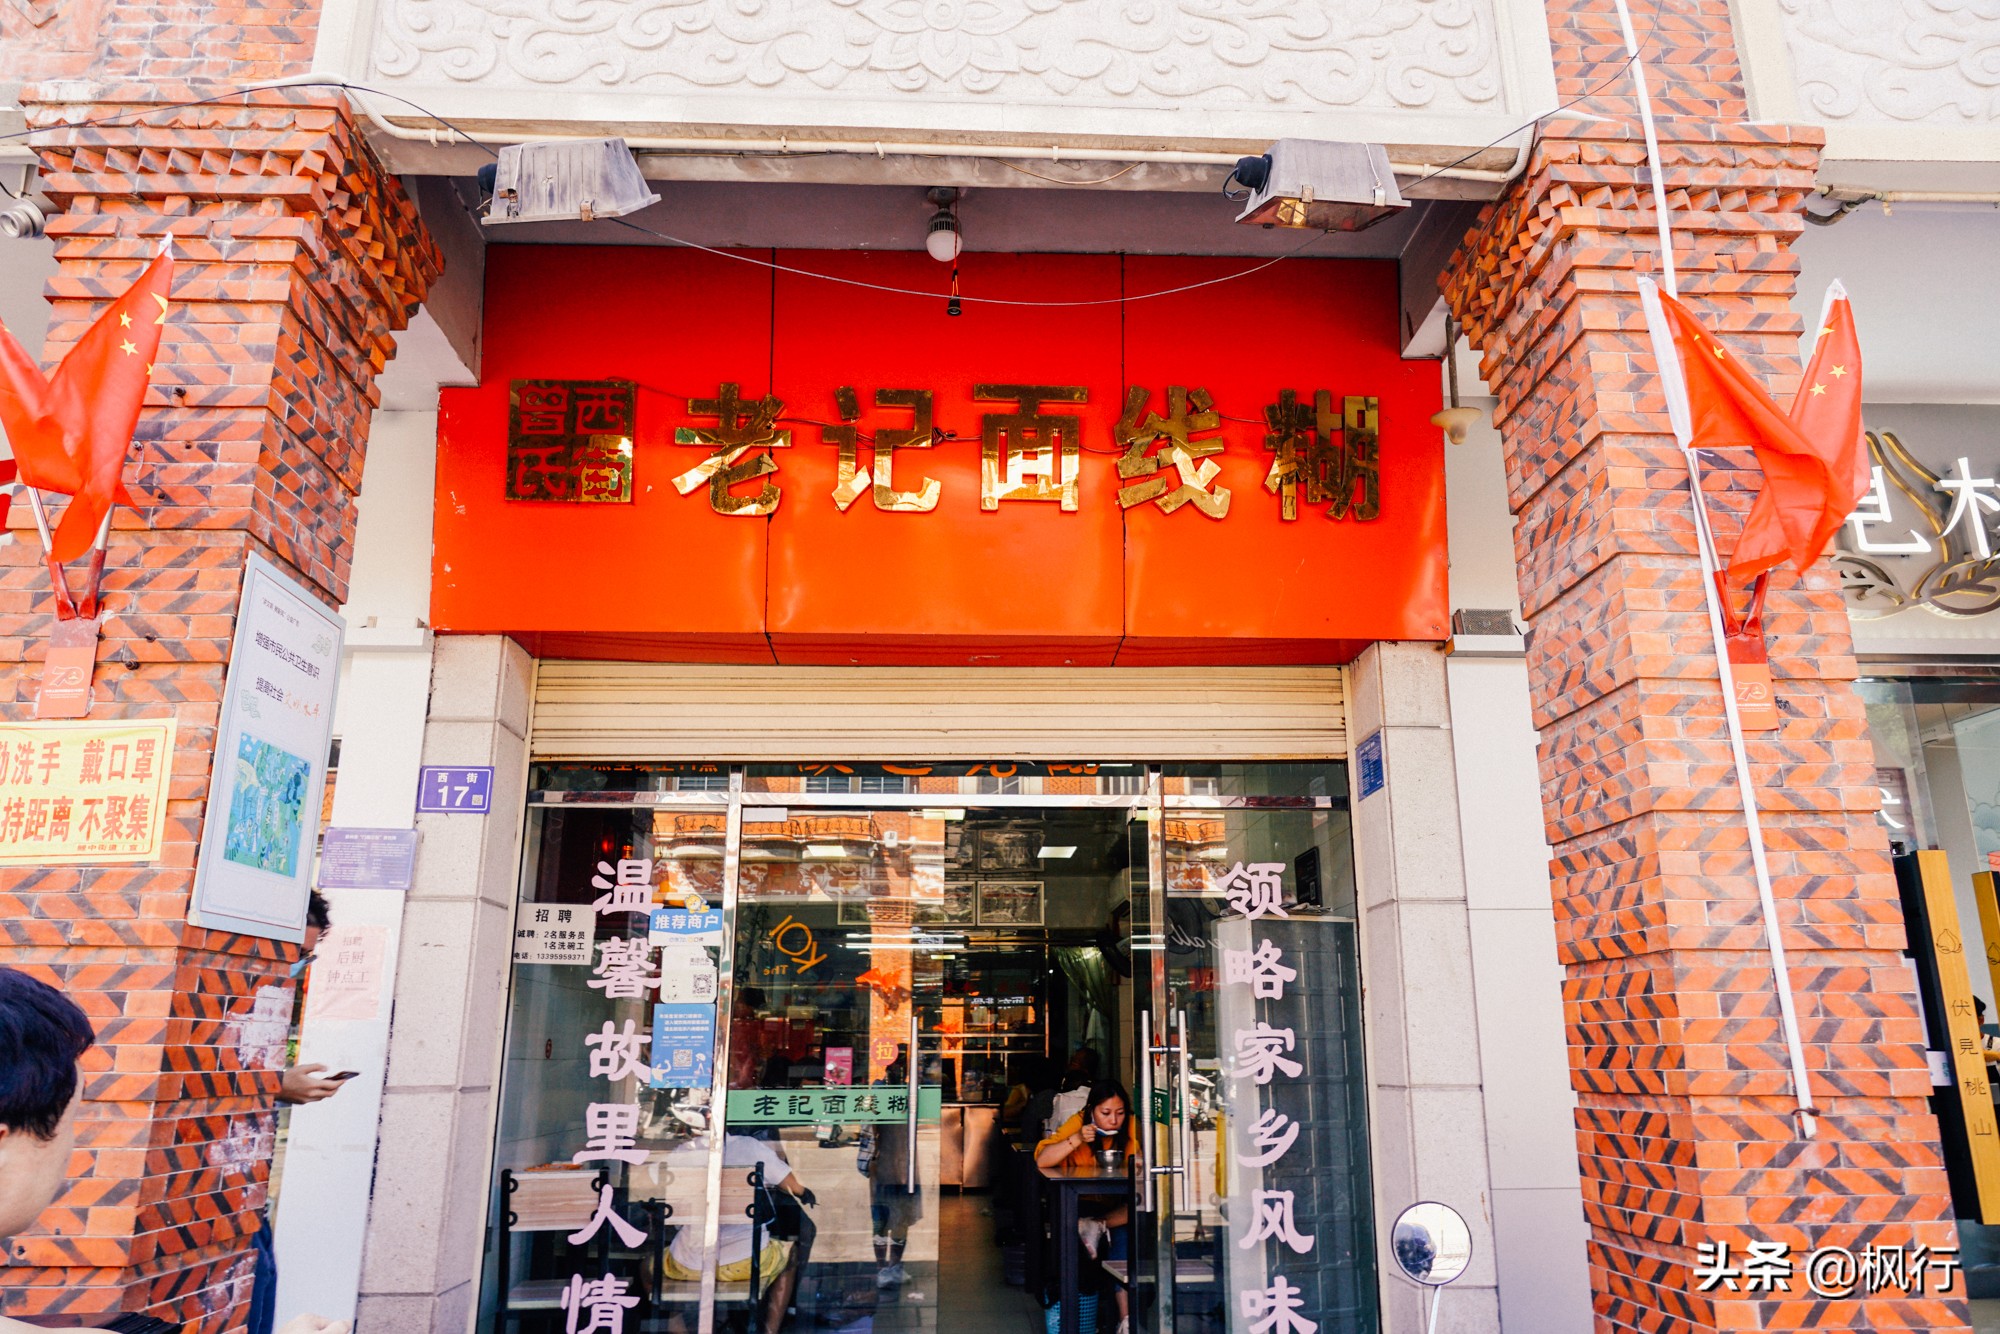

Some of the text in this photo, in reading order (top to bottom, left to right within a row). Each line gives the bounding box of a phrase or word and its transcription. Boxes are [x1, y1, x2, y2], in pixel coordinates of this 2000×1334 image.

[671, 382, 1380, 522] 老记面线糊
[255, 630, 321, 681] 增强市民公共卫生意识
[79, 738, 156, 785] 戴口罩
[437, 772, 479, 784] 西街
[437, 785, 470, 807] 17
[78, 793, 151, 842] 不聚集
[535, 908, 572, 923] 招聘
[655, 914, 719, 930] 推荐商户
[543, 942, 585, 951] 1名洗碗工
[327, 970, 369, 984] 钟点工
[875, 1041, 895, 1060] 拉
[1951, 998, 1992, 1137] 伏見桃山
[560, 858, 665, 1334] 温馨故里人情
[1216, 861, 1318, 1334] 领略家乡风味
